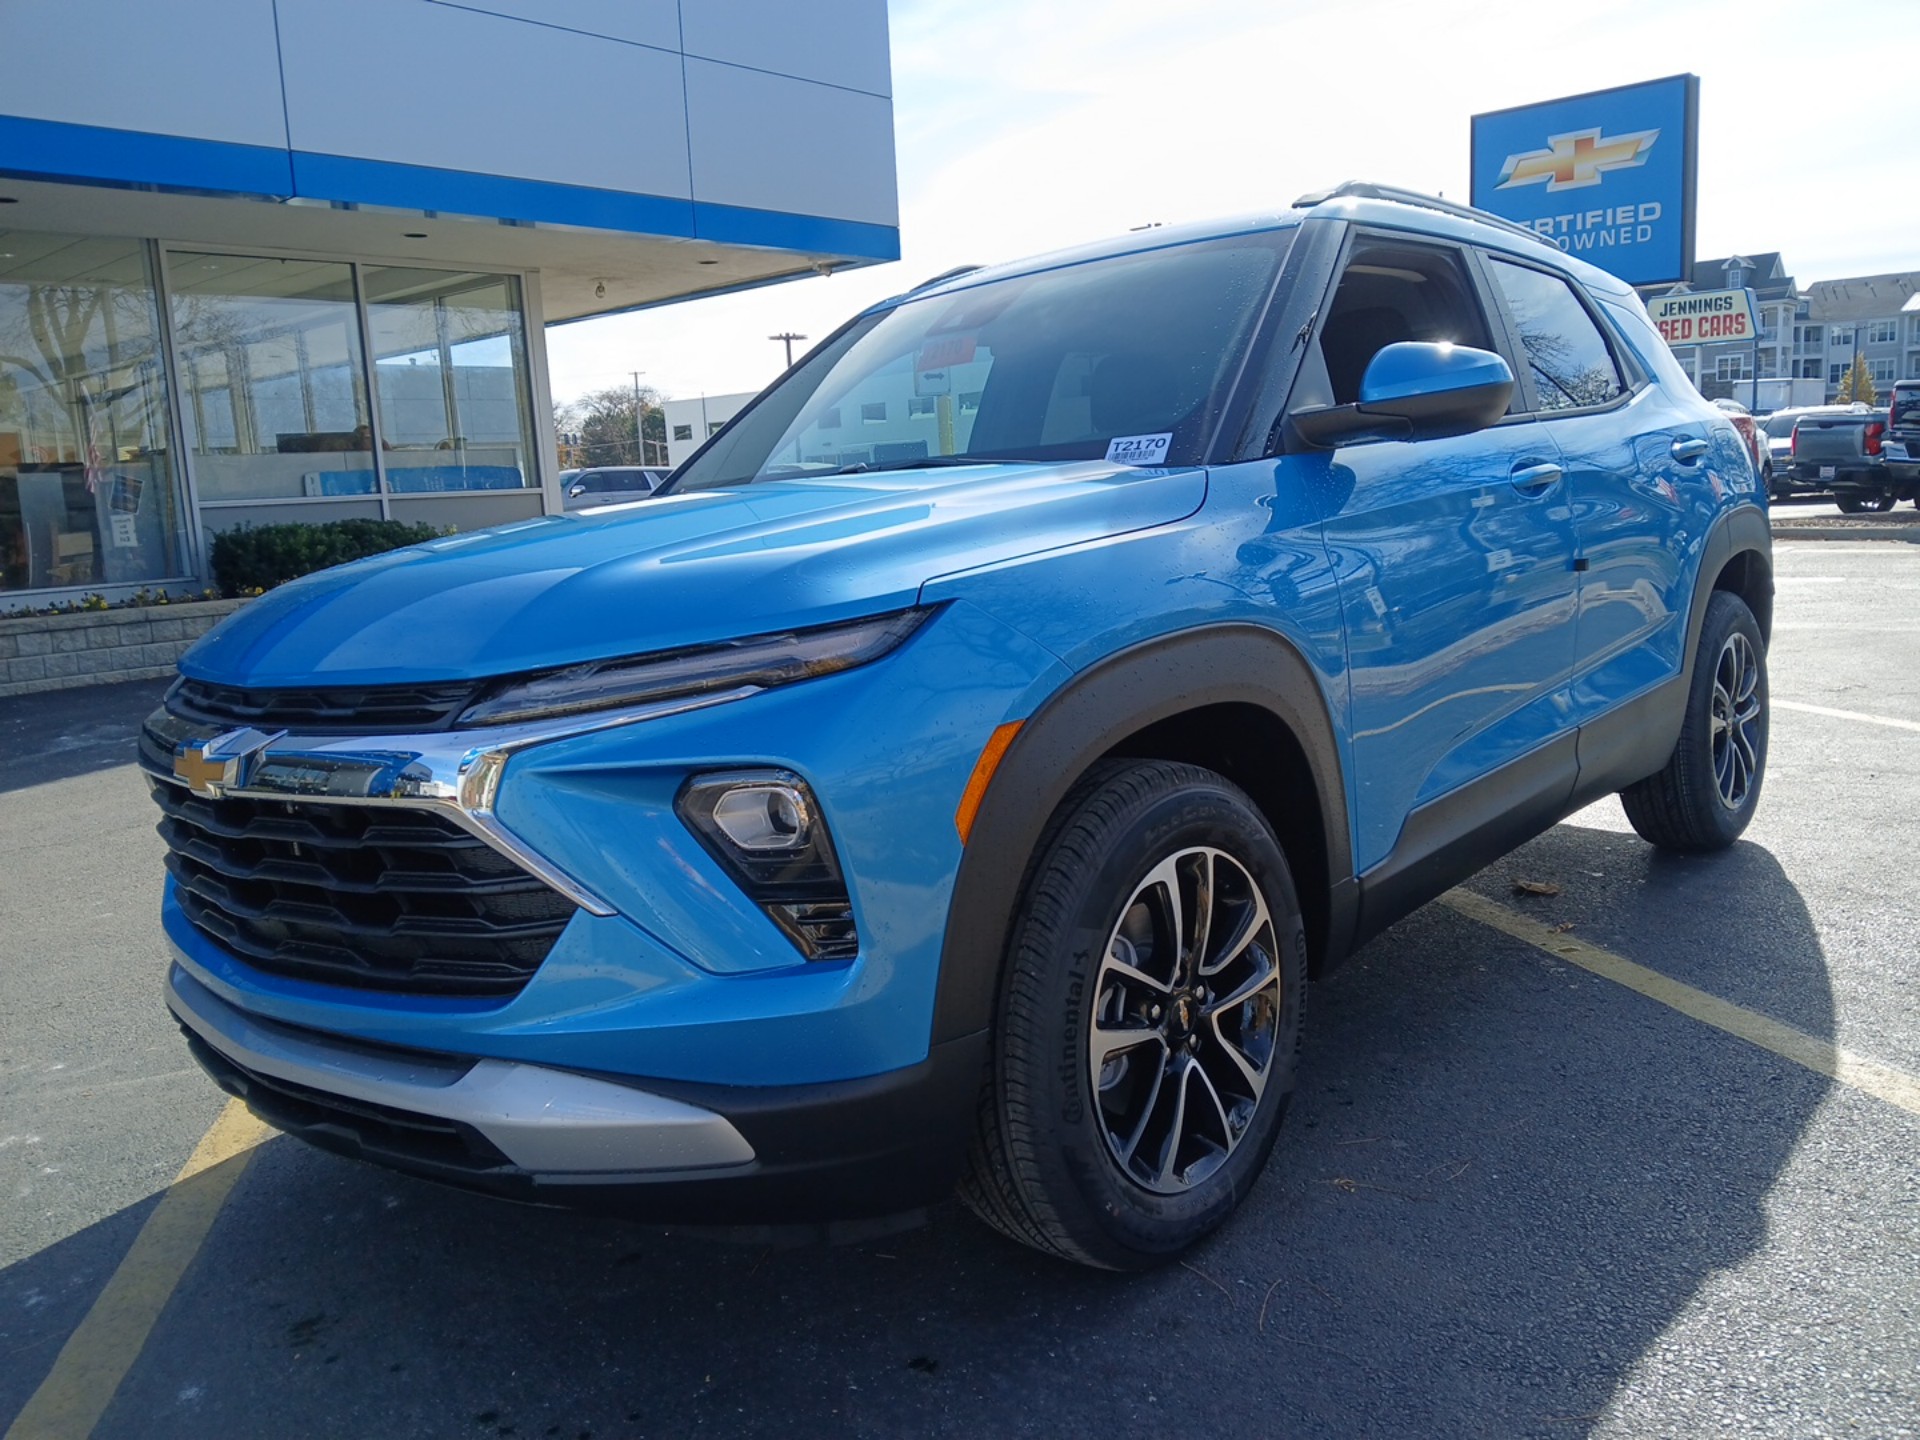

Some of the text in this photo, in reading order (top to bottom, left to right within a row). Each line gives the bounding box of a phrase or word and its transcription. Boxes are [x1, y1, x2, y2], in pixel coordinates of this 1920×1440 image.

[1659, 296, 1733, 317] JENNINGS
[1653, 312, 1746, 341] SED CARS
[1113, 438, 1167, 453] T2170
[1060, 970, 1085, 1124] Continental
